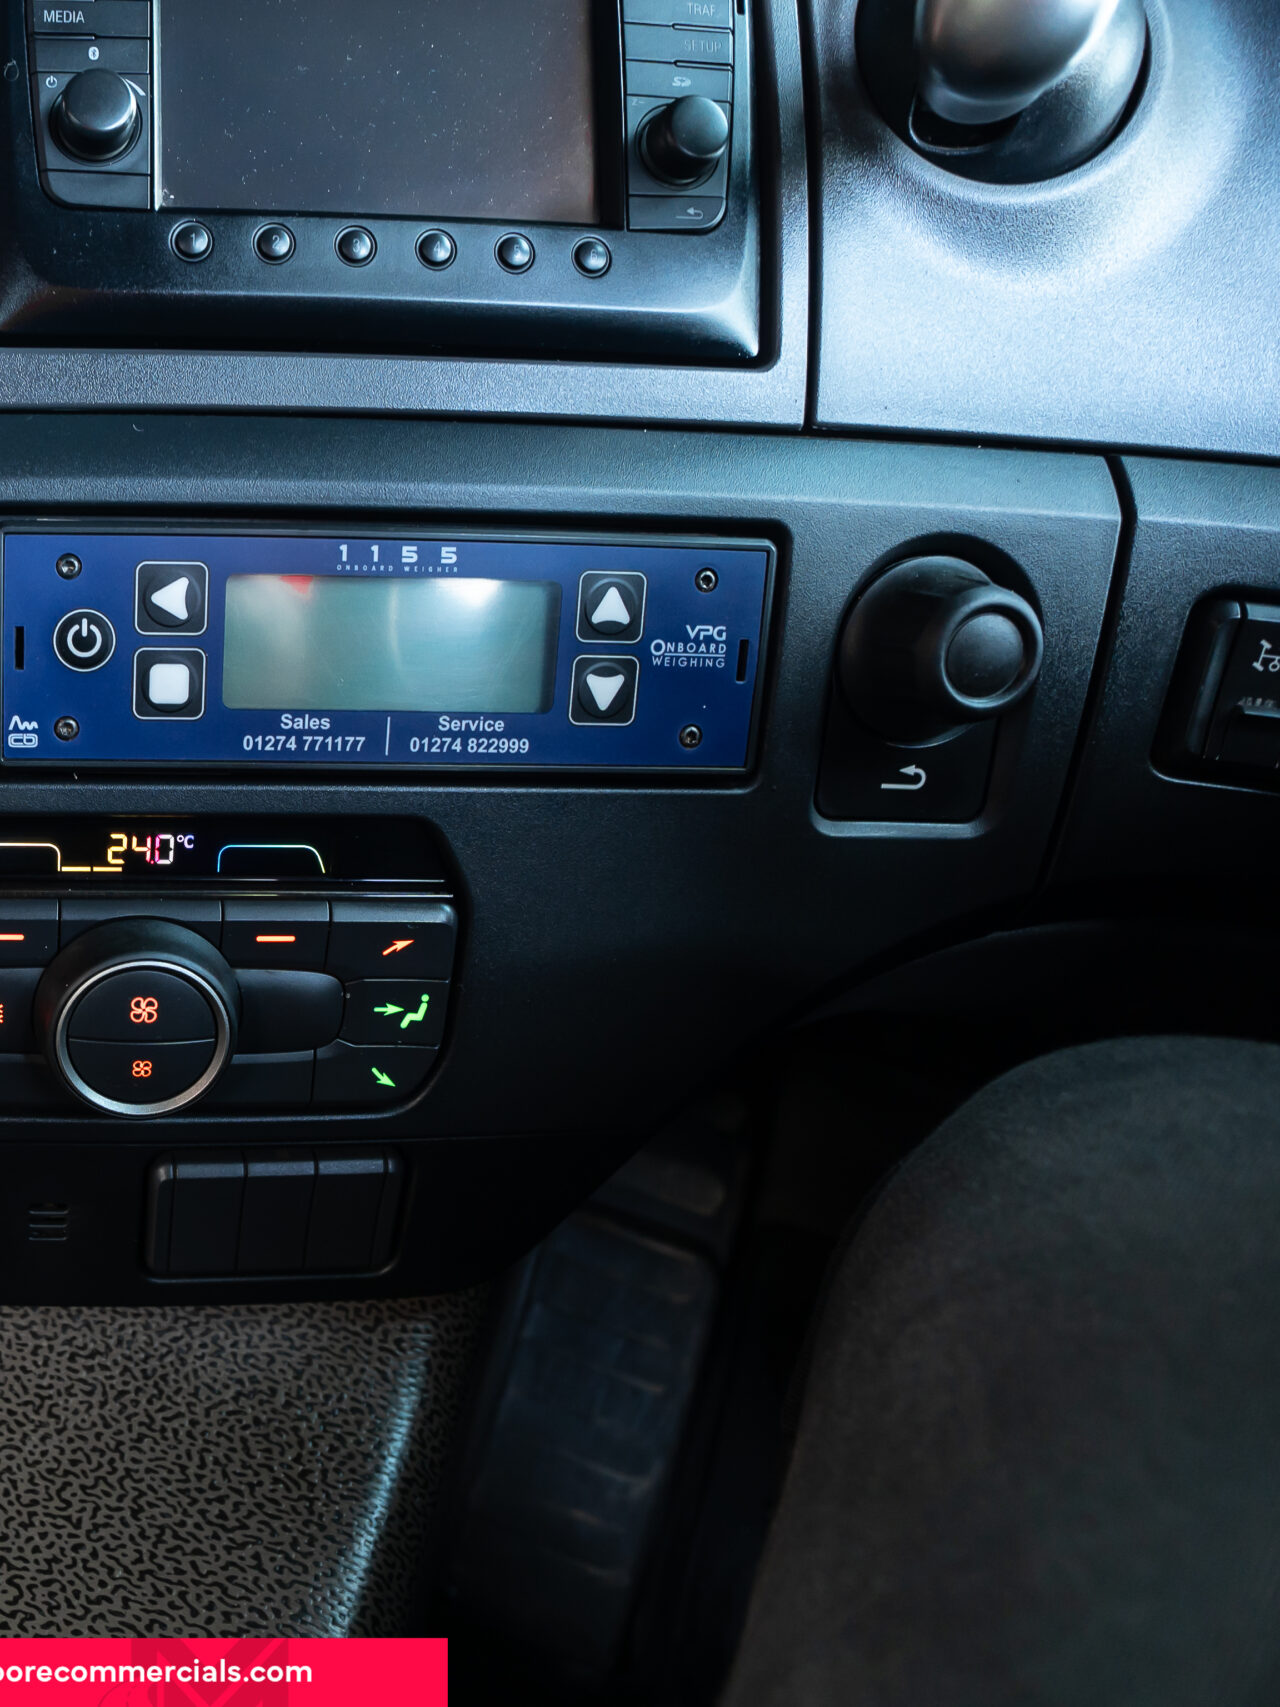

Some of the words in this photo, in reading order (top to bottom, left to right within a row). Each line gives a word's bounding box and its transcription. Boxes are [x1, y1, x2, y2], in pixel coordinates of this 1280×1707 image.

[43, 9, 85, 23] MEDIA
[190, 232, 197, 247] 1
[272, 234, 280, 250] 2
[433, 241, 441, 258] 4
[336, 564, 394, 572] ONBOARD
[685, 624, 727, 641] VPG
[650, 639, 727, 656] ONBOARD
[652, 655, 725, 668] WEIGHING
[280, 713, 331, 730] Sales
[438, 715, 505, 732] Service
[242, 735, 297, 751] 01274
[302, 736, 366, 752] 771177
[409, 737, 462, 753] 01274
[467, 738, 530, 754] 822999
